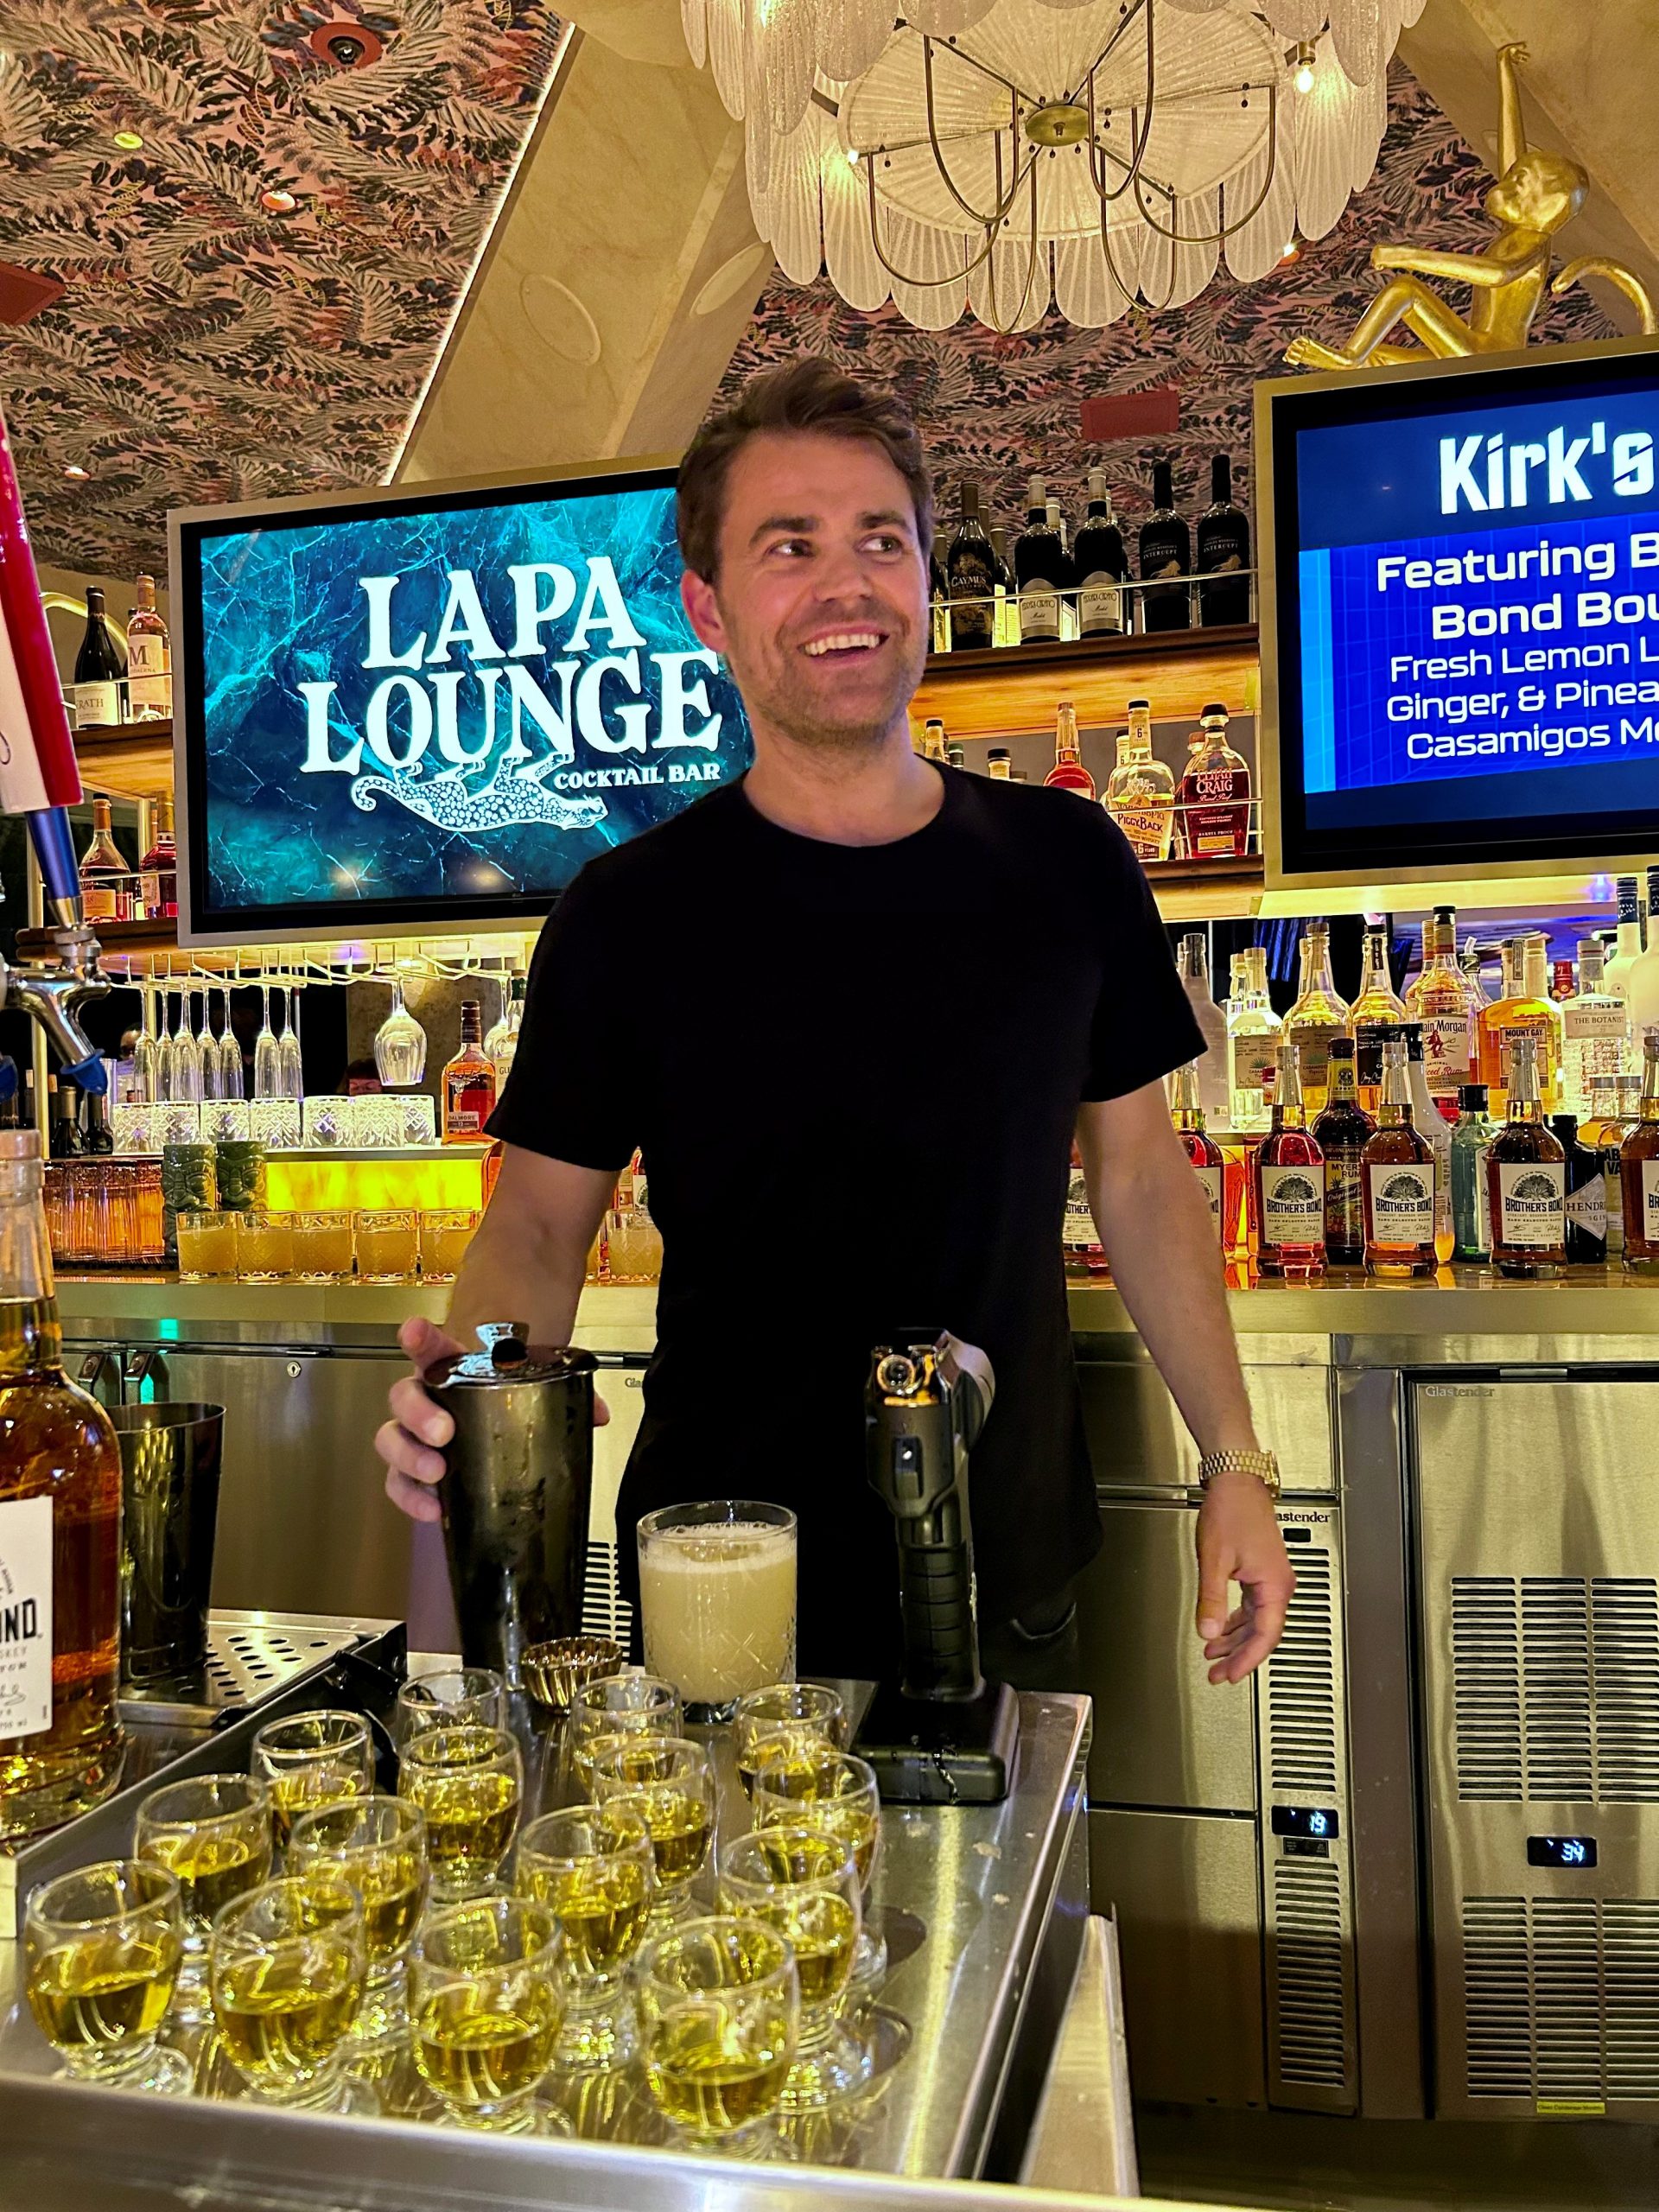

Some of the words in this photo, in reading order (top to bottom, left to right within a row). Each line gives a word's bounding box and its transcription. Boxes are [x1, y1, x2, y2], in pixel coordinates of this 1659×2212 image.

[1439, 422, 1655, 515] Kirk's
[1377, 540, 1615, 592] Featuring
[951, 576, 987, 588] CAYMUS
[359, 556, 647, 671] LAPA
[1432, 594, 1562, 640] Bond
[1390, 648, 1492, 683] Fresh
[1502, 641, 1629, 674] Lemon
[297, 648, 723, 776] LOUNGE
[1387, 693, 1509, 724] Ginger,
[1518, 685, 1547, 713] &
[1136, 728, 1142, 738] 6
[1407, 723, 1611, 760] Casamigos
[553, 768, 664, 791] COCKTAIL
[664, 763, 721, 785] BAR
[1196, 779, 1233, 794] CRAIG
[1137, 842, 1144, 855] 6
[1435, 1020, 1467, 1033] Morgan
[1592, 1015, 1624, 1024] BOTANIST
[1505, 1029, 1529, 1038] MOUNT
[1531, 1027, 1543, 1037] GAY
[1267, 1198, 1305, 1213] BROTHER'S
[1376, 1197, 1415, 1212] BROTHER'S
[1505, 1197, 1547, 1212] BROTHER'S
[1426, 1385, 1496, 1397] Glastender
[1276, 1511, 1331, 1523] astender
[0, 1598, 36, 1643] ND
[1310, 1814, 1326, 1833] 19
